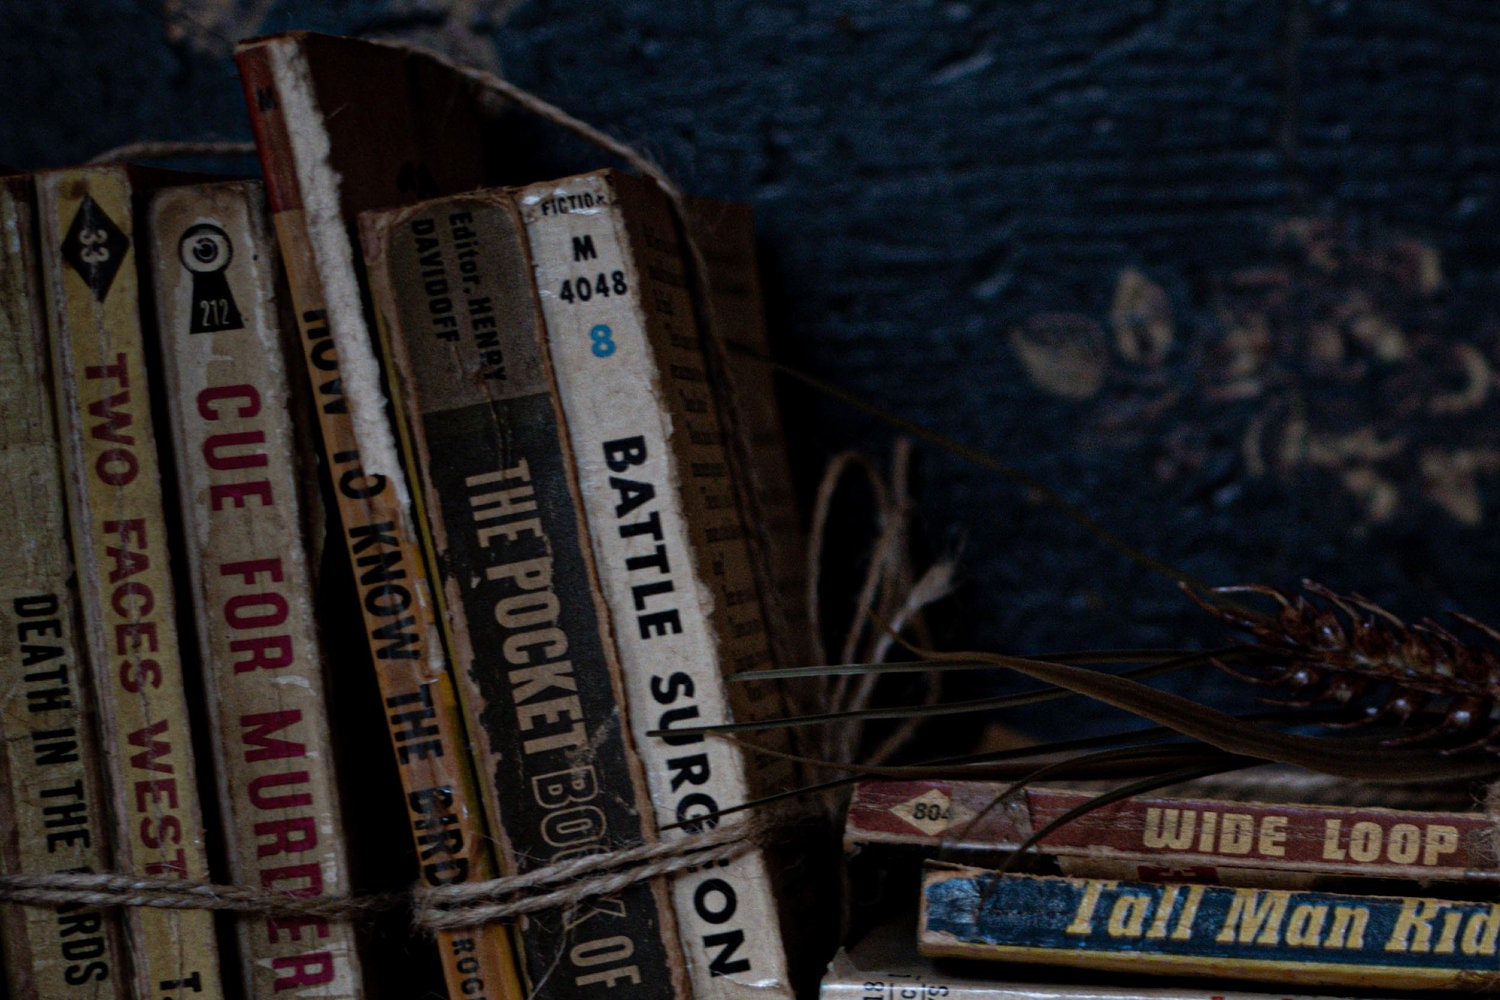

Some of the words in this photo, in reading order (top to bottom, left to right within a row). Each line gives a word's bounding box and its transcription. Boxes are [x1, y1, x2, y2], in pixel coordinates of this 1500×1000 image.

[77, 227, 109, 263] 33
[411, 219, 459, 343] DAVIDOFF
[560, 270, 628, 303] 4048
[572, 235, 597, 261] M
[200, 299, 232, 328] 212
[468, 296, 507, 383] HENRY
[590, 324, 617, 357] 8
[86, 353, 138, 486] TWO
[197, 385, 273, 511] CUE
[465, 456, 549, 549] THE
[103, 519, 163, 693] FACES
[220, 557, 293, 676] FOR
[349, 519, 421, 661] KNOW
[14, 593, 71, 713] DEATH
[486, 552, 592, 756] POCKET
[32, 728, 78, 767] IN
[387, 684, 443, 764] THE
[603, 435, 682, 640] BATTLE
[650, 671, 750, 978] SURGON
[40, 780, 90, 853] THE
[128, 719, 187, 880] WEST
[410, 786, 468, 886] BIRD
[531, 764, 627, 931] BOK
[1142, 807, 1289, 857] WIDE
[1323, 818, 1460, 866] LOOP
[240, 710, 334, 992] MURDER
[54, 866, 108, 986] RDS
[569, 934, 641, 988] OF
[1066, 881, 1205, 941] Tall
[1215, 889, 1372, 951] Man
